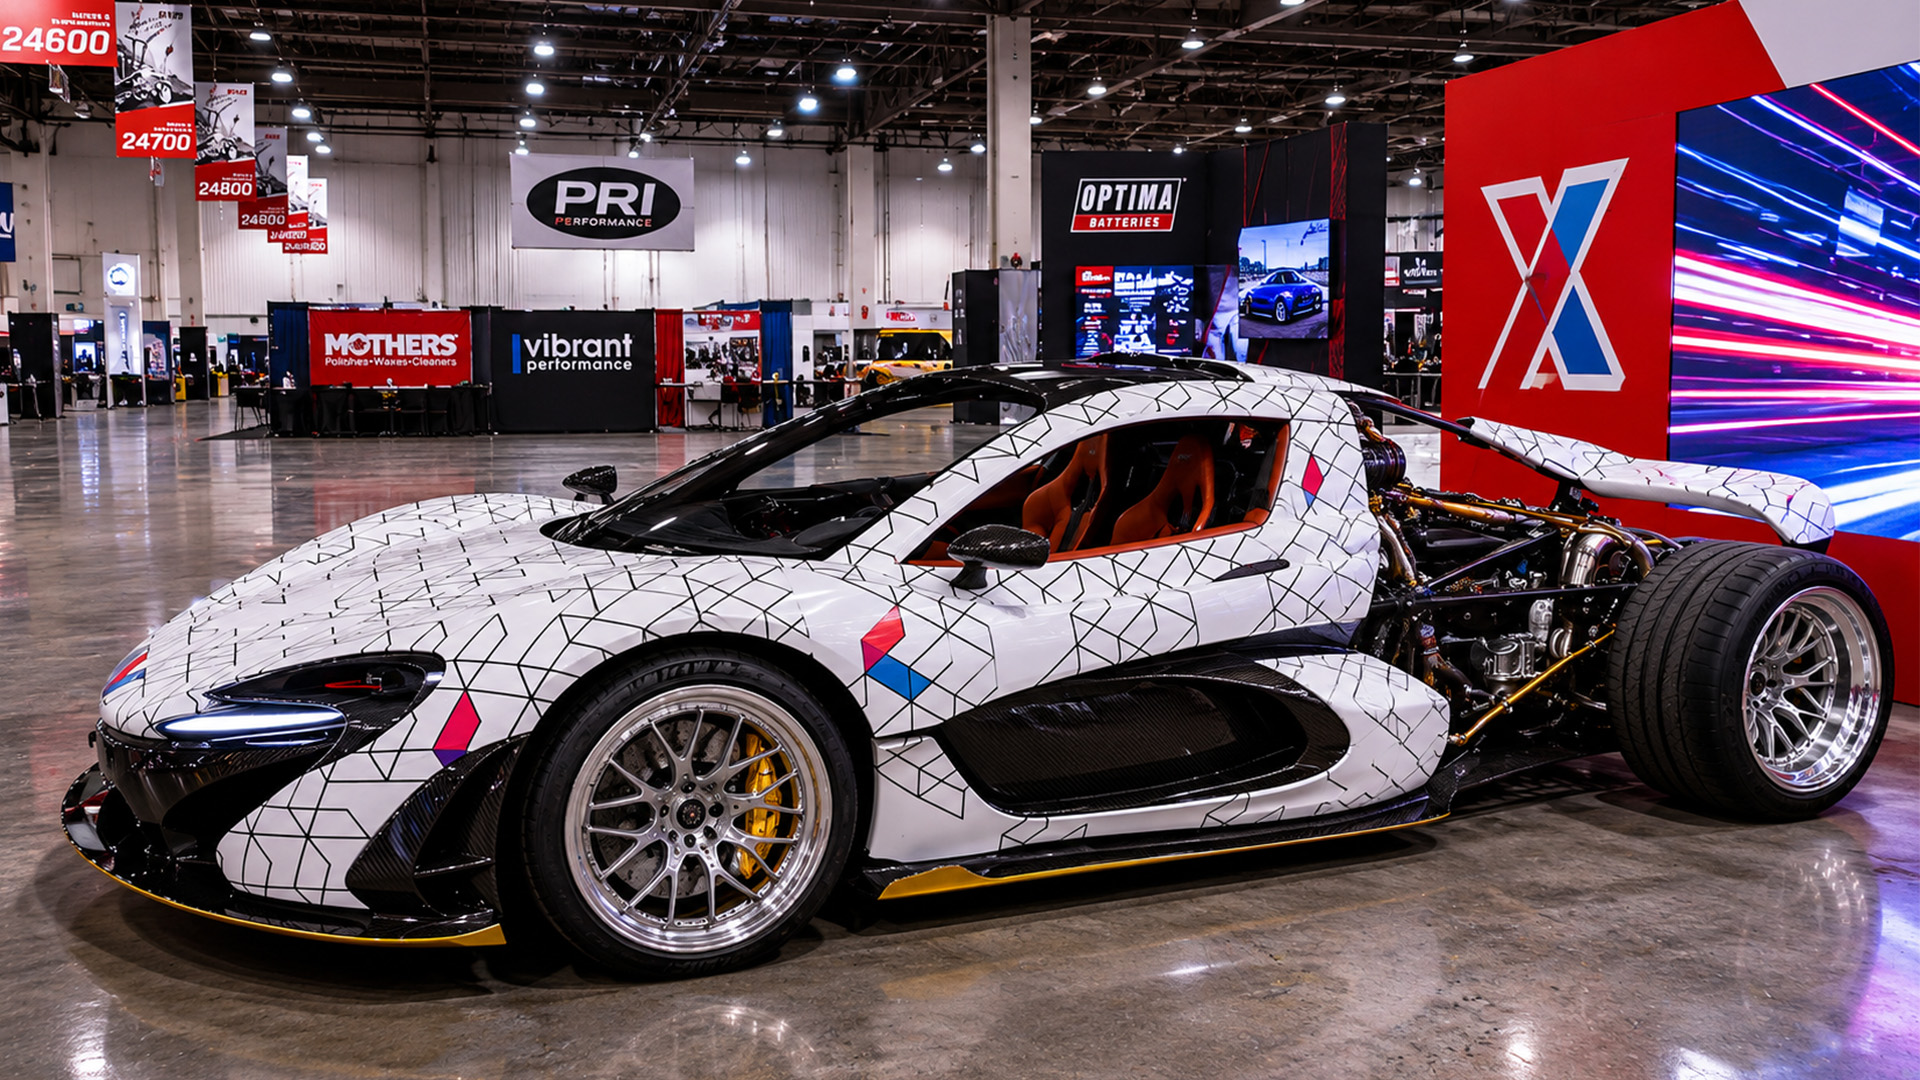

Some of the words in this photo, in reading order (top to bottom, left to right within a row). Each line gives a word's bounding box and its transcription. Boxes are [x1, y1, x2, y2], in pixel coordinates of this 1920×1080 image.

[1, 26, 111, 55] 24600
[122, 132, 191, 151] 24700
[199, 182, 253, 196] 24800
[554, 180, 656, 216] PRI
[1080, 184, 1173, 211] OPTIMA
[241, 214, 286, 226] 24800
[555, 217, 652, 228] PERFORMANCE
[1089, 217, 1160, 228] BATTERIES
[324, 333, 458, 356] MOTHERS
[523, 333, 633, 358] vibrant
[526, 358, 632, 374] performance
